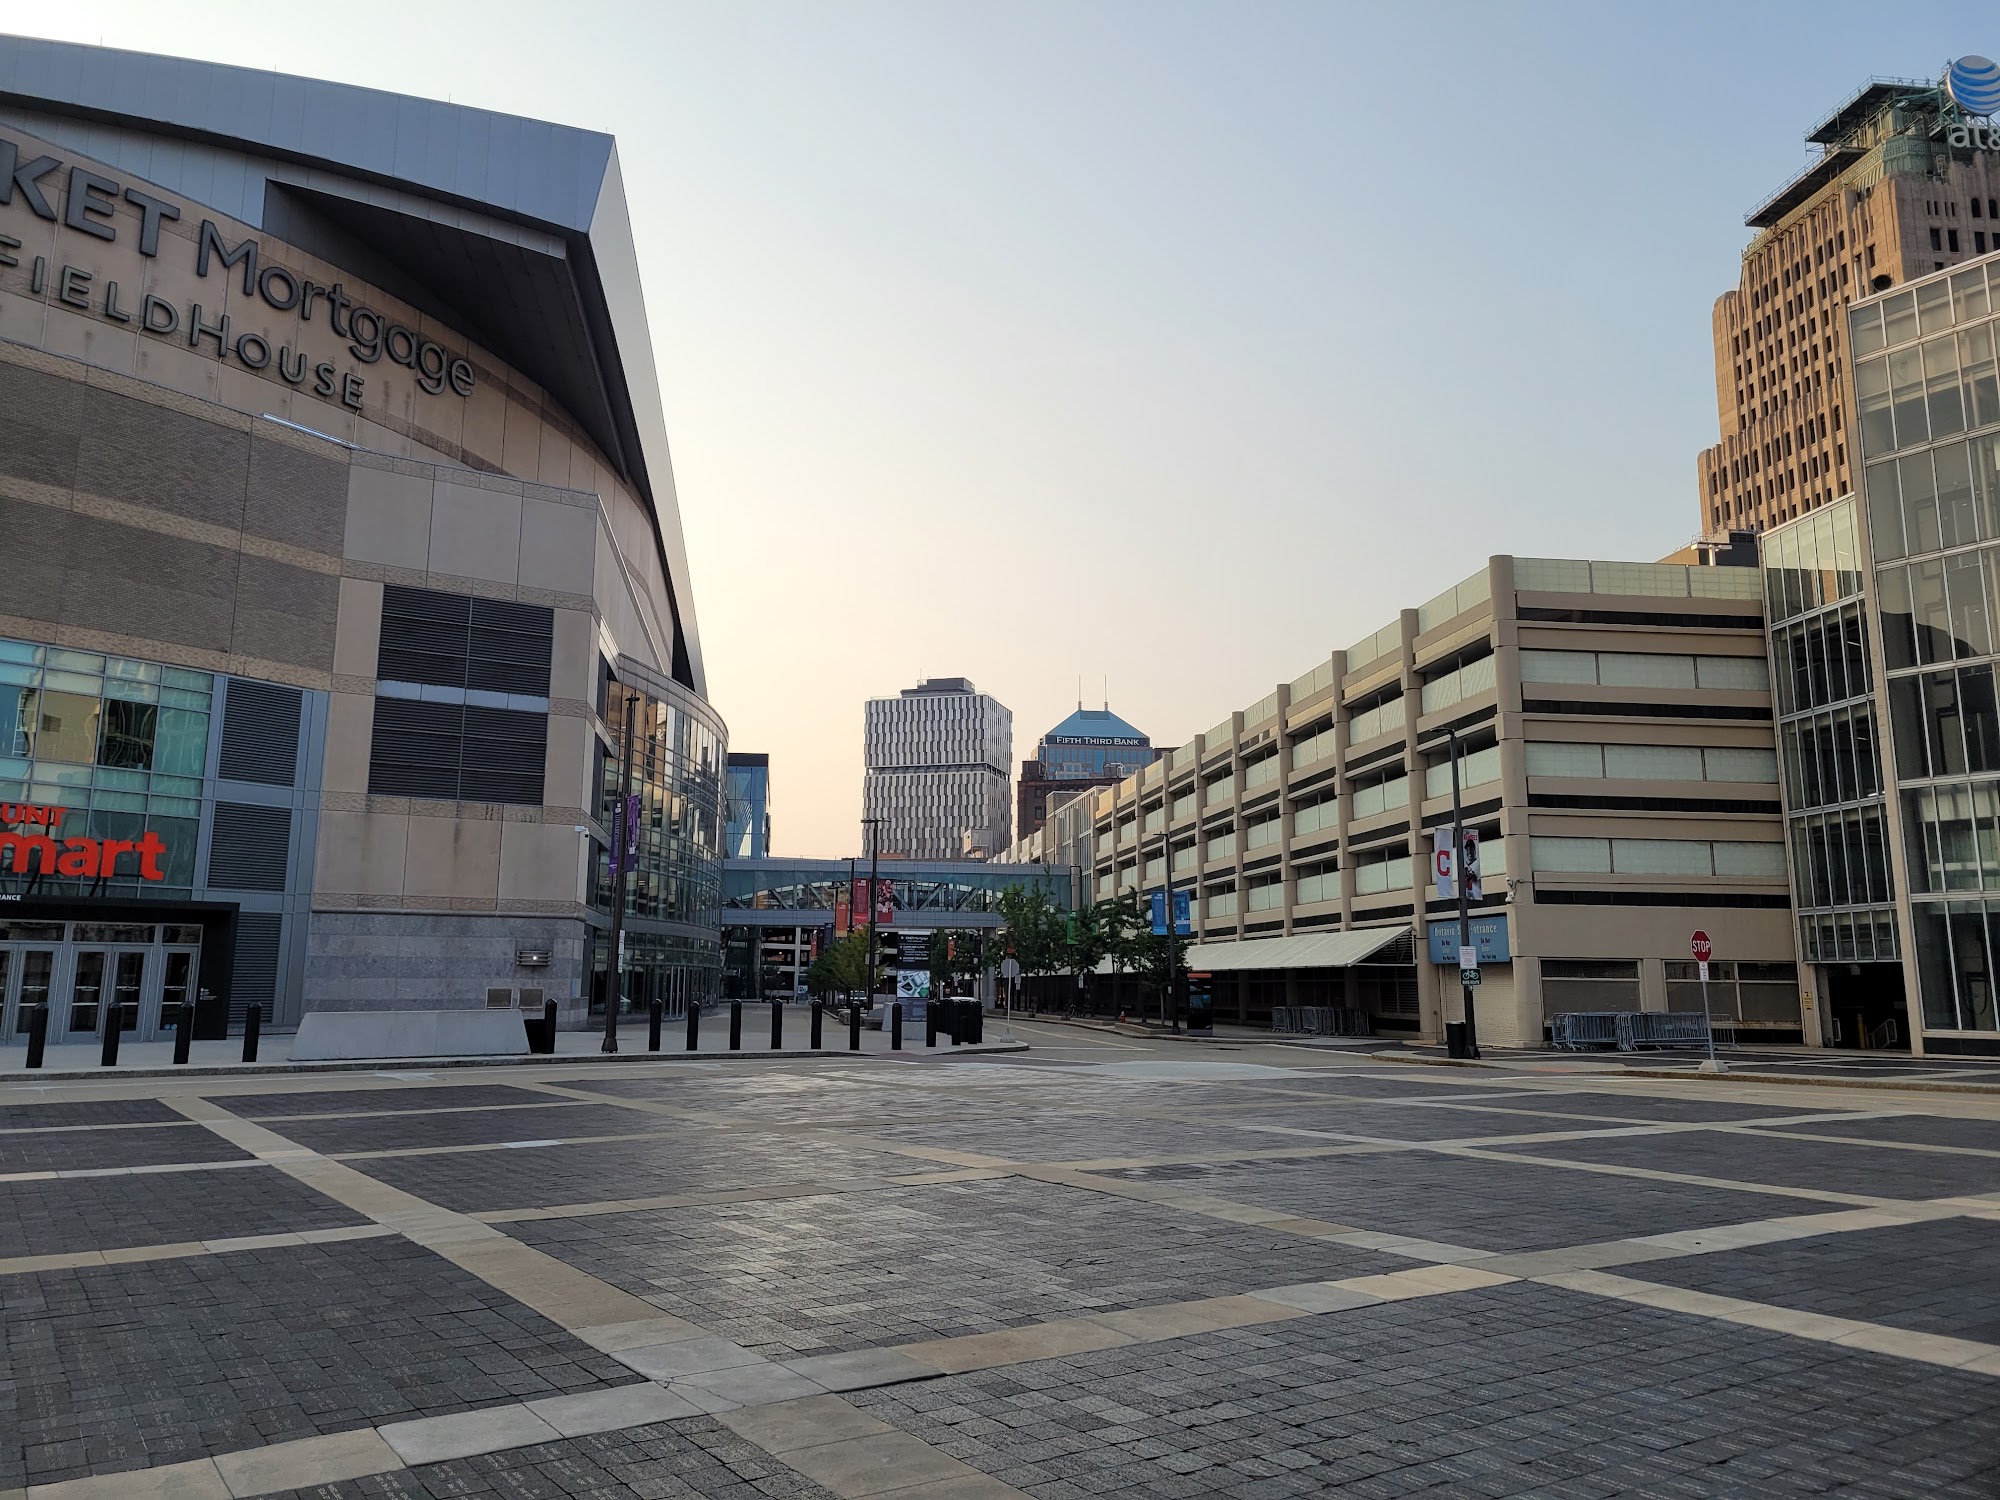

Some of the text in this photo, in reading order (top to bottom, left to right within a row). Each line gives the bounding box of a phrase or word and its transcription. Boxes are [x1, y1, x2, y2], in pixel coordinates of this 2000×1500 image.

[197, 219, 476, 397] Mortgage
[1056, 736, 1140, 746] FIFTH THIRD BANK
[1436, 850, 1450, 876] C
[1470, 924, 1497, 935] Entrance
[1692, 940, 1711, 952] STOP
